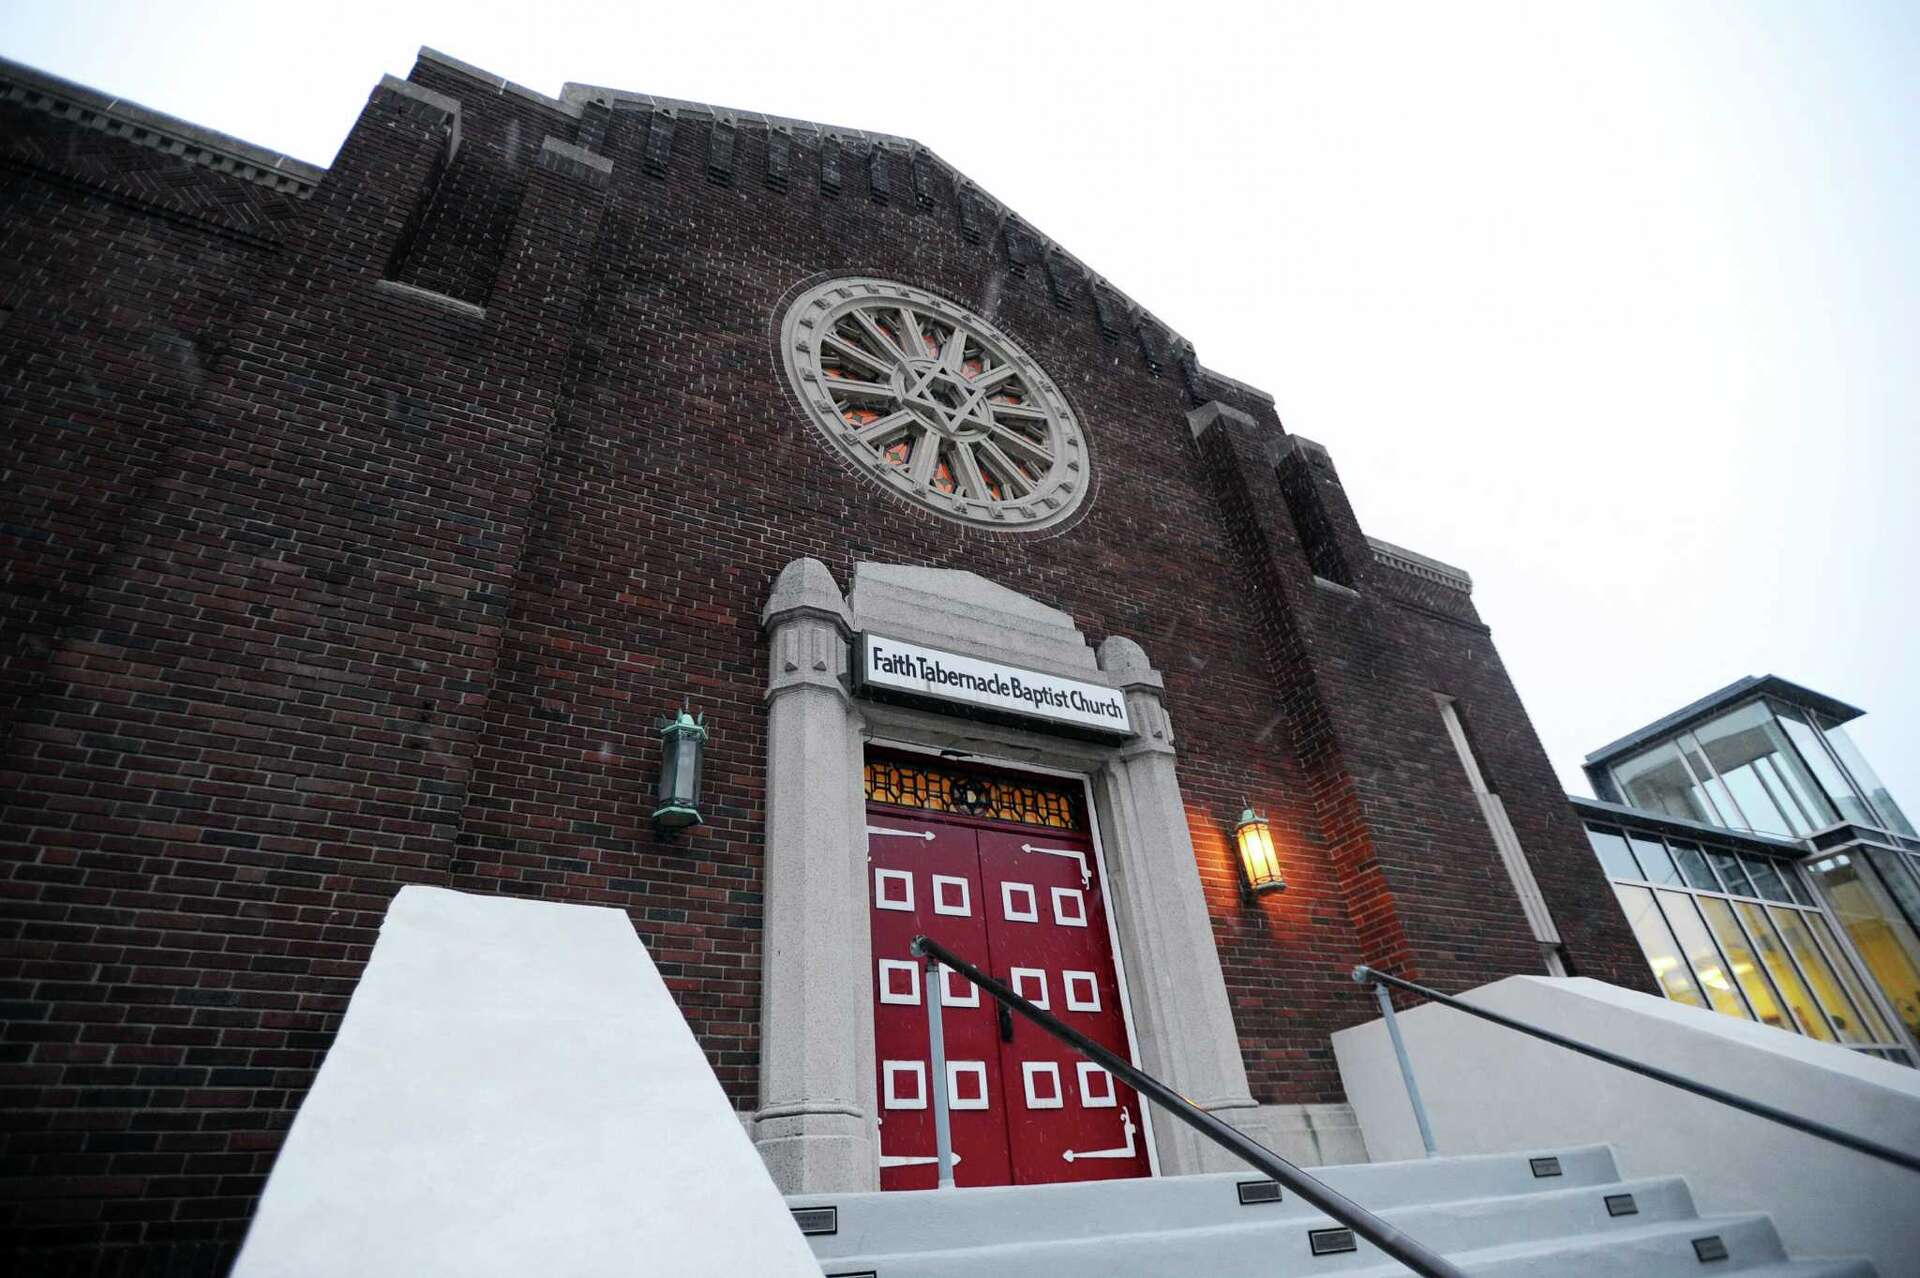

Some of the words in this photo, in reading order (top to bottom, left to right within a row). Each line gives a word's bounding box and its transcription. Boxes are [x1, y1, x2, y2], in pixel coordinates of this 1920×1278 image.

[873, 647, 917, 678] Faith
[917, 657, 1010, 696] Tabernacle
[1010, 677, 1071, 709] Baptist
[1071, 690, 1123, 719] Church
